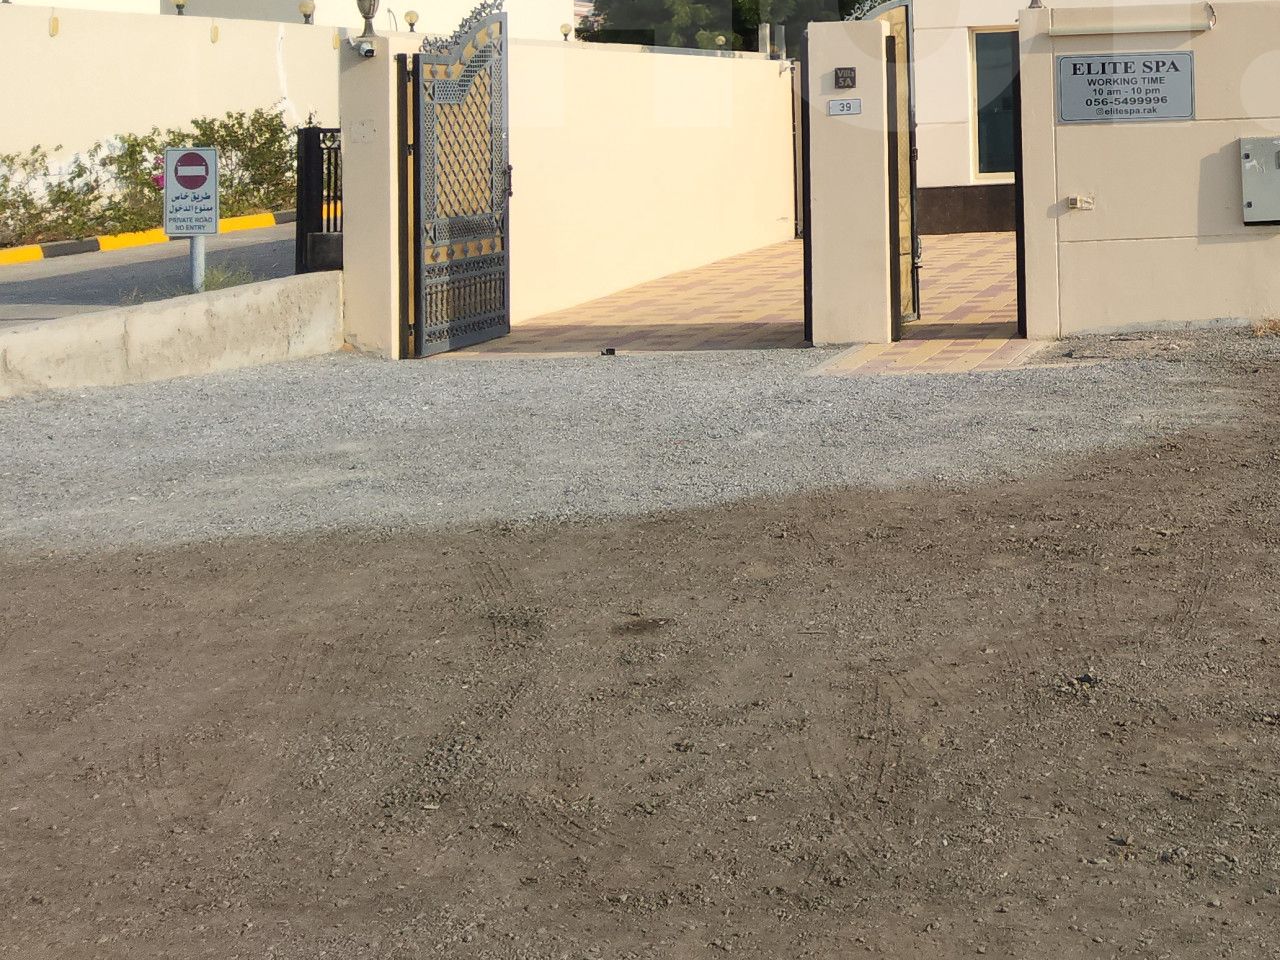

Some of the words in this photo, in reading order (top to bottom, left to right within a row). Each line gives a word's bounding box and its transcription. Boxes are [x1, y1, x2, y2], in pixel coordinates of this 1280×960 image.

[1072, 61, 1136, 76] ELITE
[1142, 59, 1180, 74] SPA
[1087, 77, 1138, 87] WORKING
[1141, 76, 1166, 85] TIME
[1093, 88, 1104, 96] 10
[1131, 87, 1142, 95] 10
[1145, 87, 1160, 96] pm
[839, 102, 852, 112] 39
[1085, 96, 1168, 107] 056-5499996
